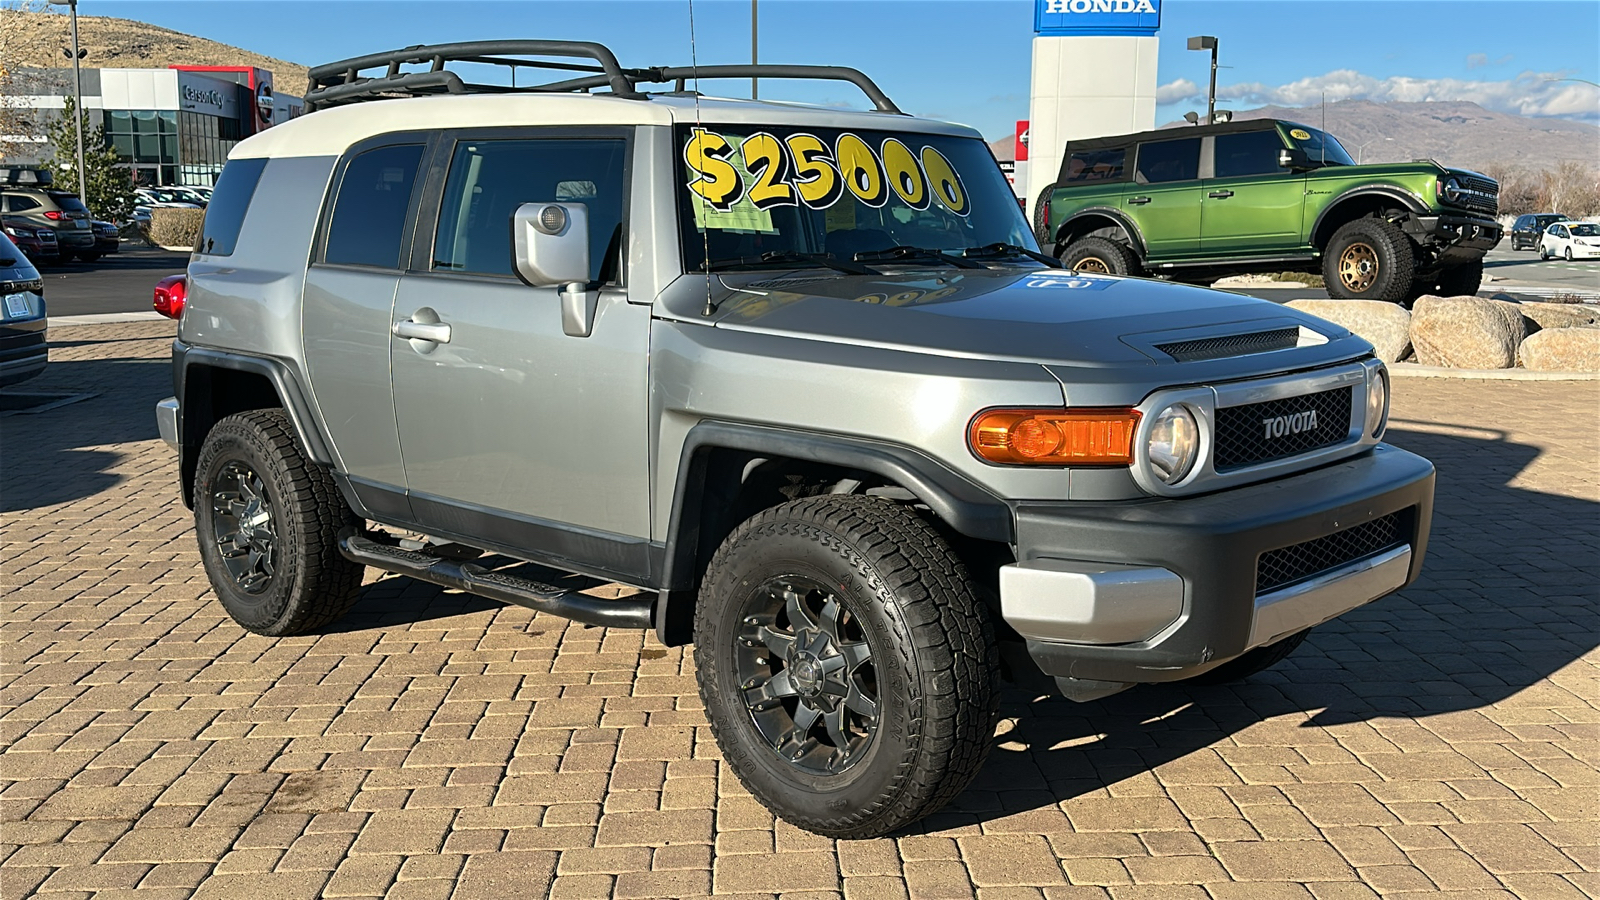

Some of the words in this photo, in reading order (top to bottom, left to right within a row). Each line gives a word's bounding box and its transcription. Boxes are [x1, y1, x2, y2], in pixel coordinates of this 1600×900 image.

[1045, 0, 1156, 13] HONDA
[184, 85, 210, 104] Carson
[210, 90, 225, 109] City
[683, 126, 972, 218] $25000
[1263, 410, 1318, 440] TOYOTA
[841, 572, 874, 612] ALL
[875, 618, 904, 743] TERRAIN
